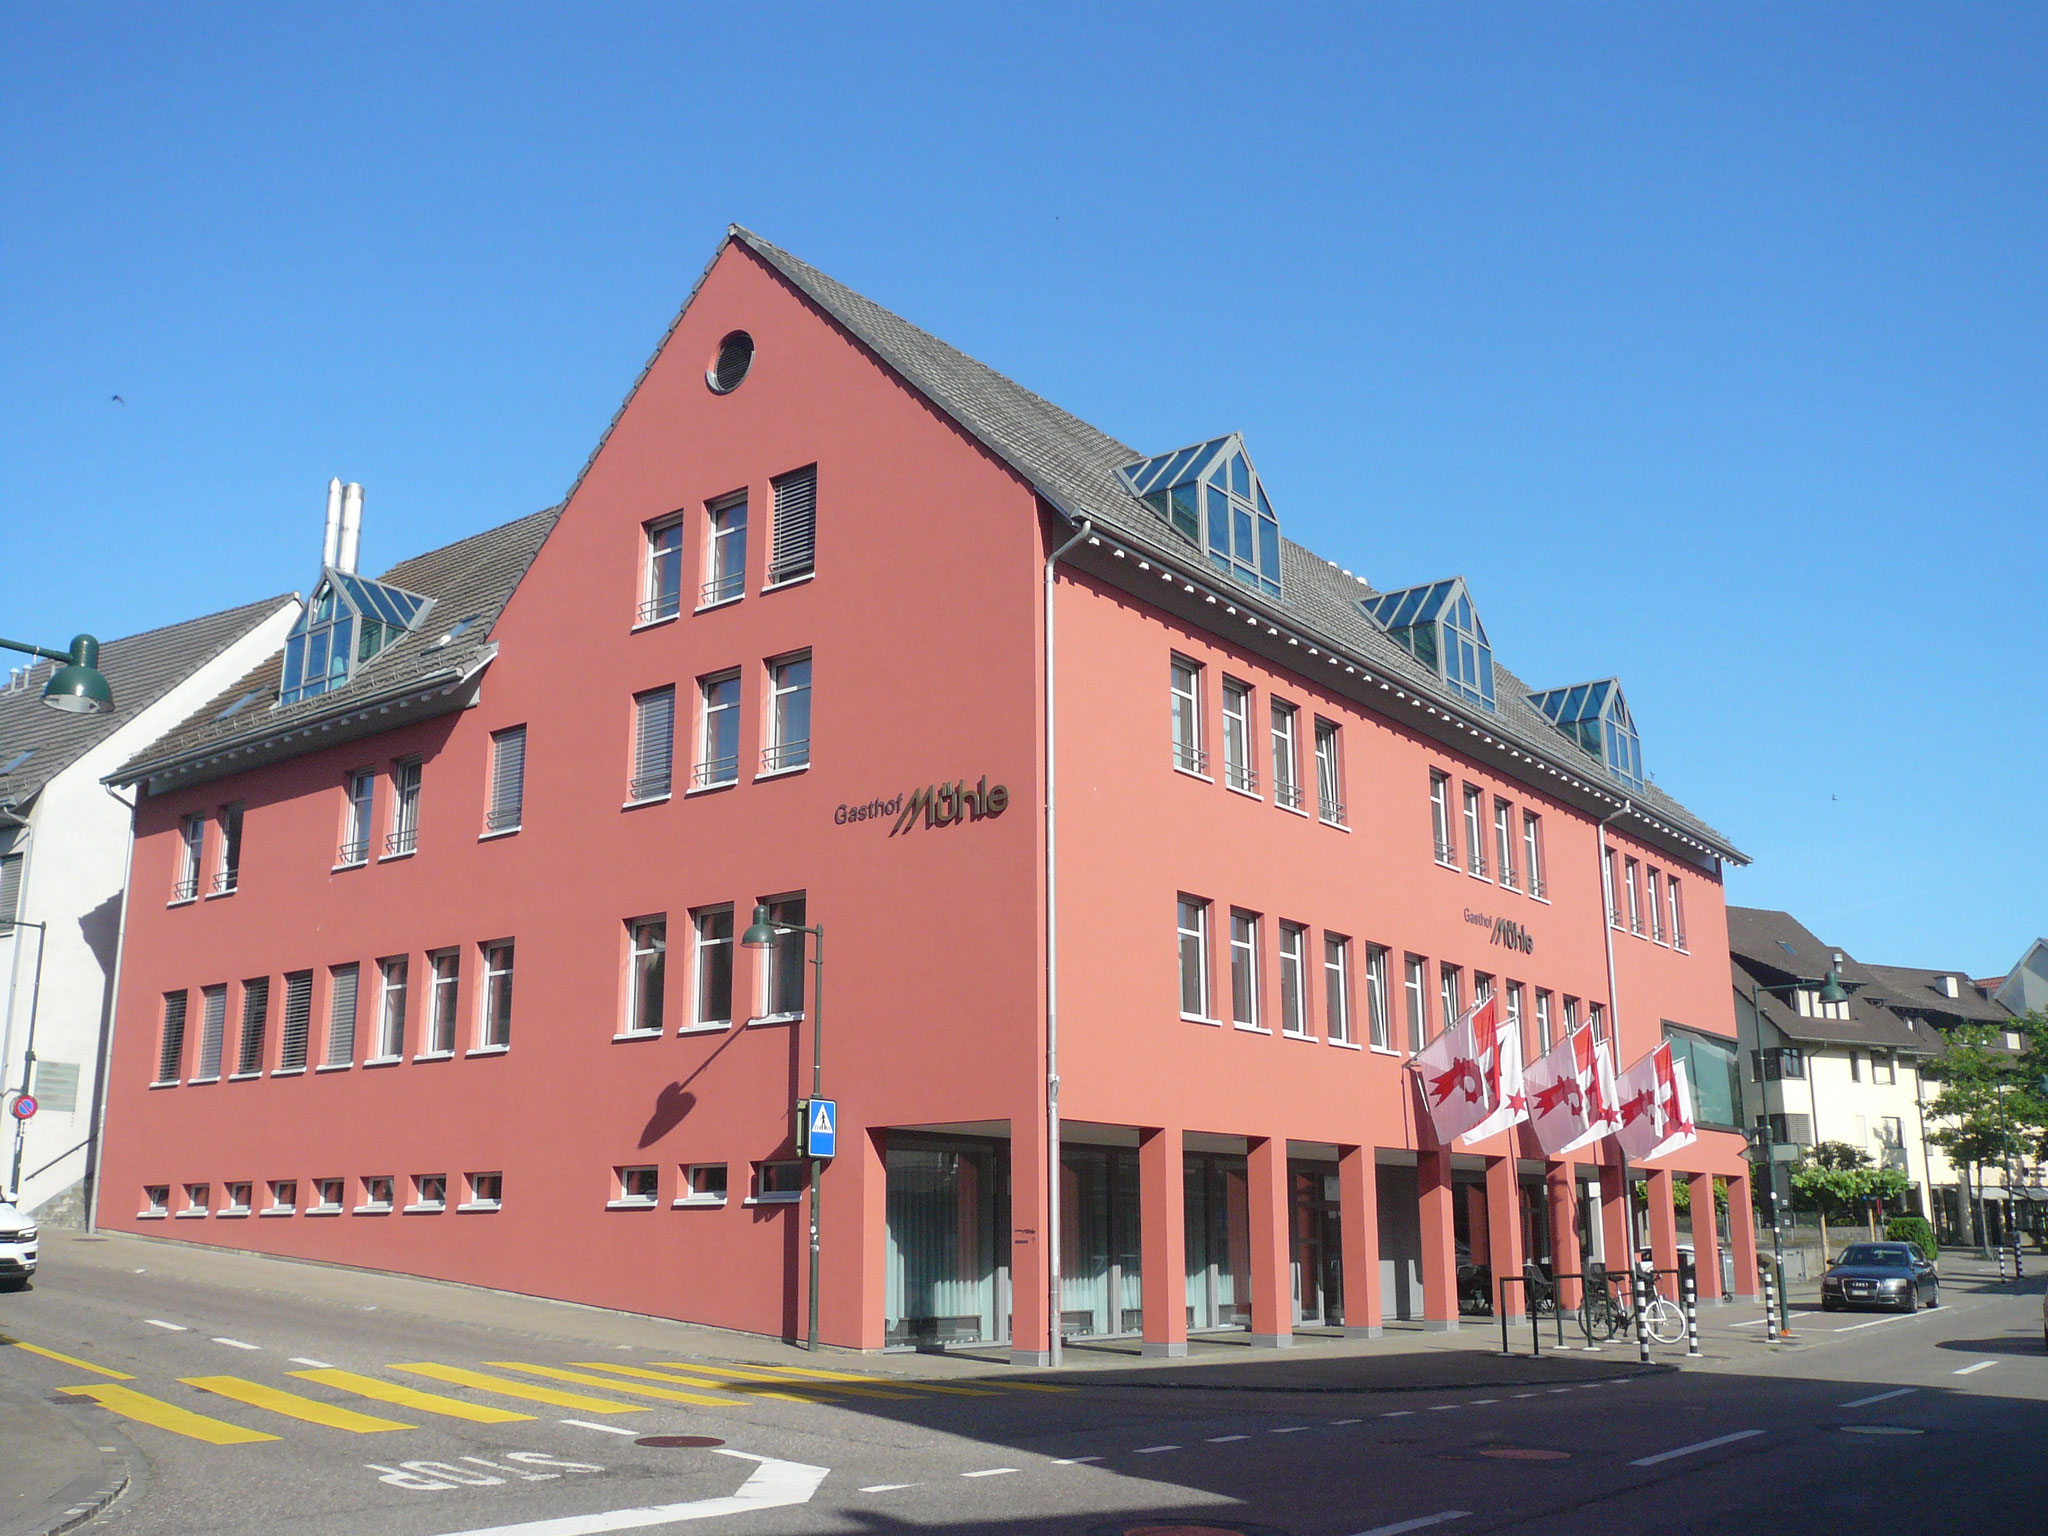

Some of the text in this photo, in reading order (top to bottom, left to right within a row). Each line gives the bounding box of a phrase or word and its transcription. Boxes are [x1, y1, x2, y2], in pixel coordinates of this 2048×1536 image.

[834, 775, 1010, 836] Gasthof Mühle
[1463, 907, 1533, 955] Gasthof Mühle
